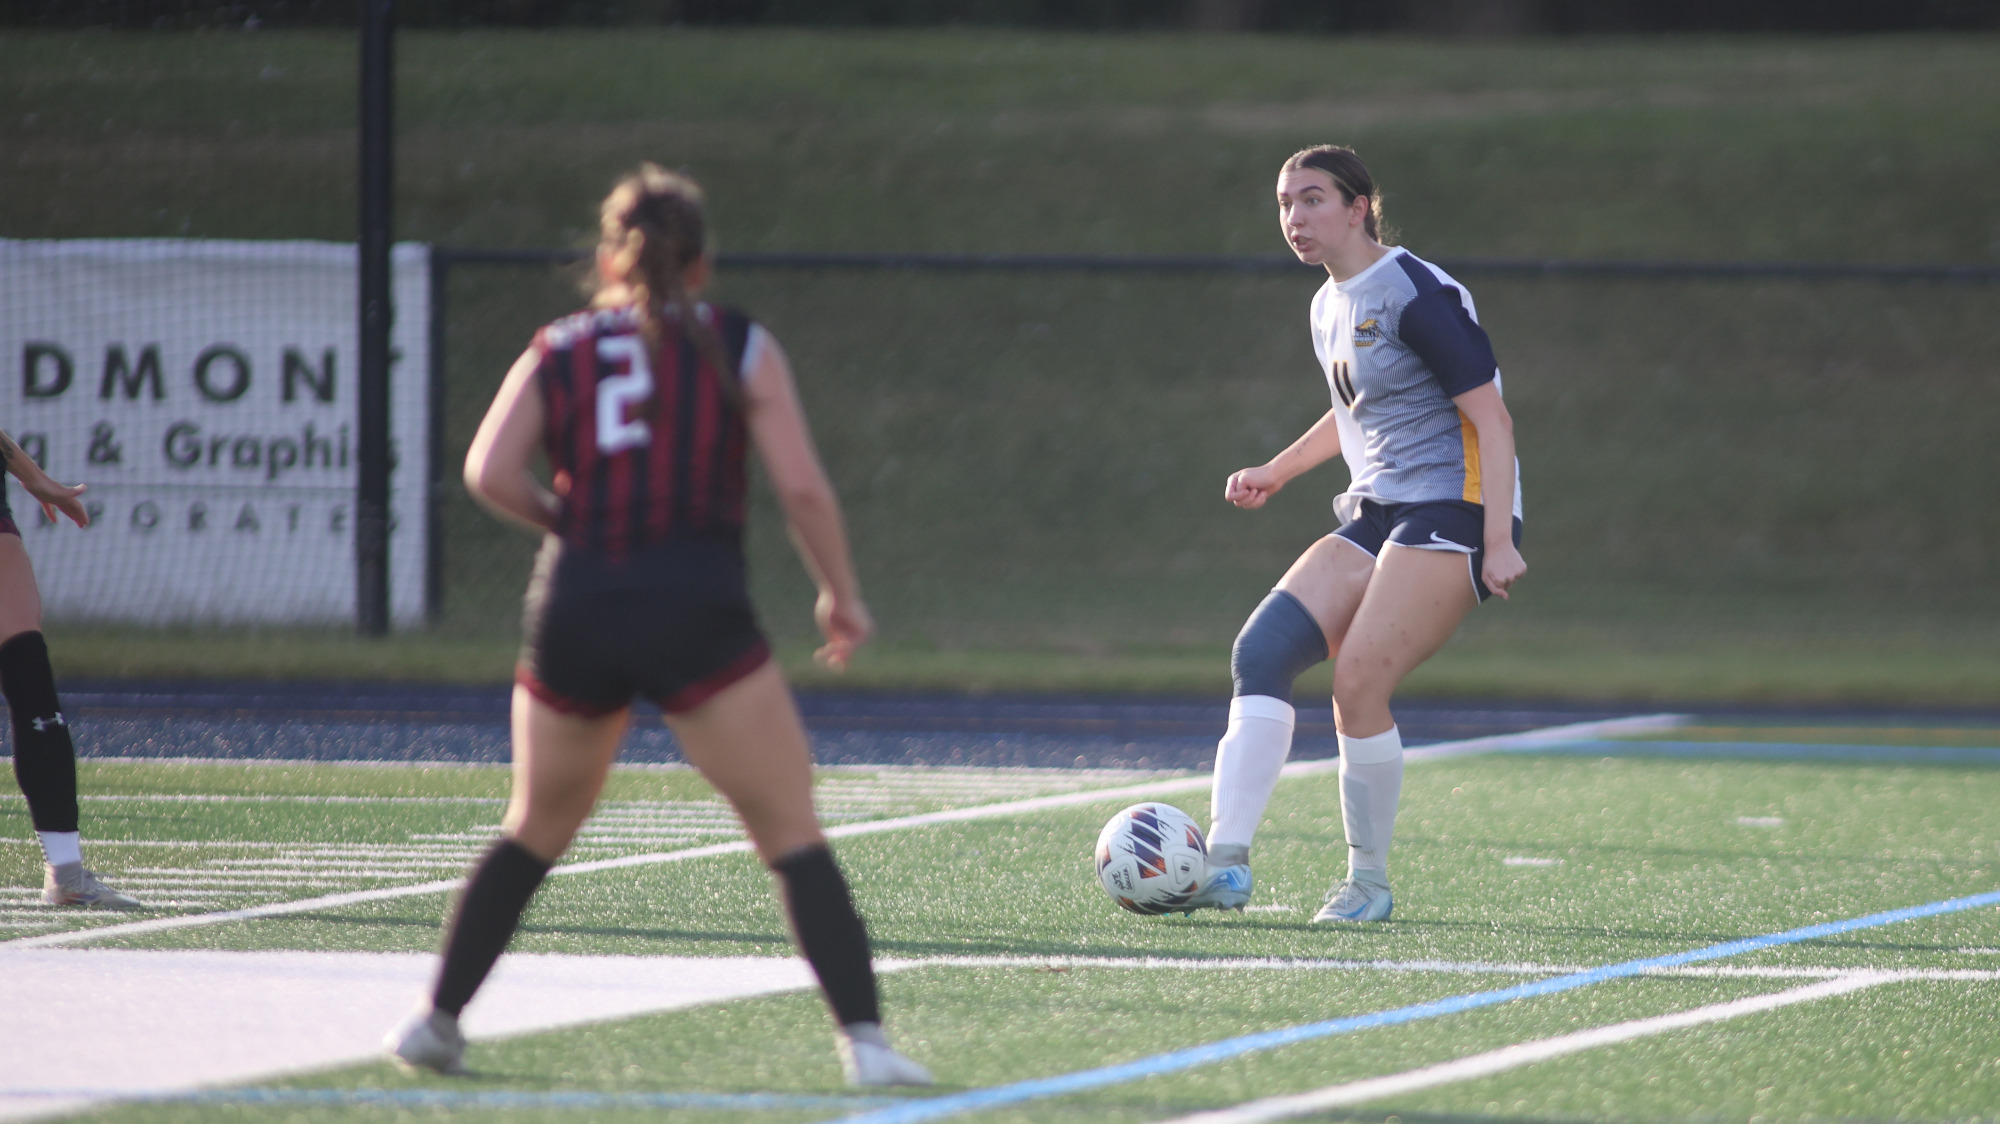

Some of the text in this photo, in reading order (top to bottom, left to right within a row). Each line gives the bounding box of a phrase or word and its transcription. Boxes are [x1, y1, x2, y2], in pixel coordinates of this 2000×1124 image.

[22, 341, 402, 403] DMON
[596, 333, 653, 453] 2
[1333, 360, 1356, 408] 11
[86, 420, 122, 467] &
[163, 421, 399, 482] Graphi
